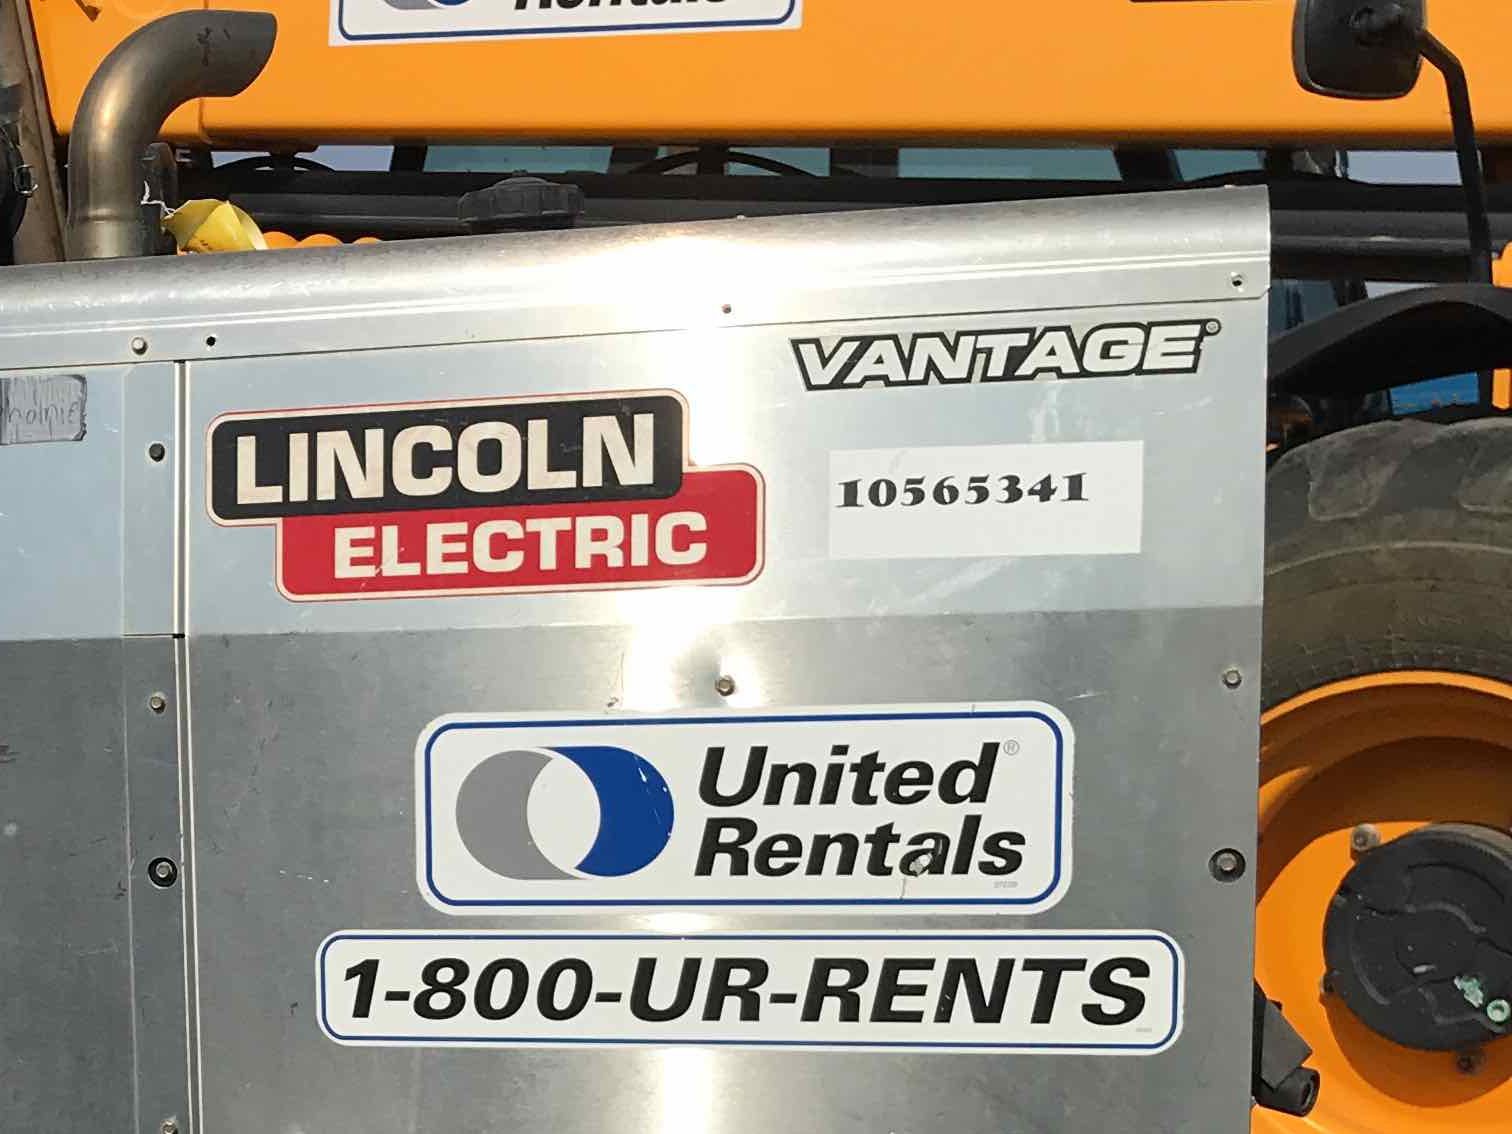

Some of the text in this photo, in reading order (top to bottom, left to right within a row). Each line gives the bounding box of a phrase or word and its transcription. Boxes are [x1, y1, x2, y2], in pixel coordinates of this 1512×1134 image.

[791, 319, 1205, 391] VANTAGE
[236, 412, 656, 505] LINCOLN
[835, 471, 1089, 509] 10565341
[333, 511, 709, 580] ELECTRIC
[698, 741, 1001, 808] United
[694, 813, 1027, 877] Rentals
[341, 956, 1152, 1026] 1-800-UR-RENTS
